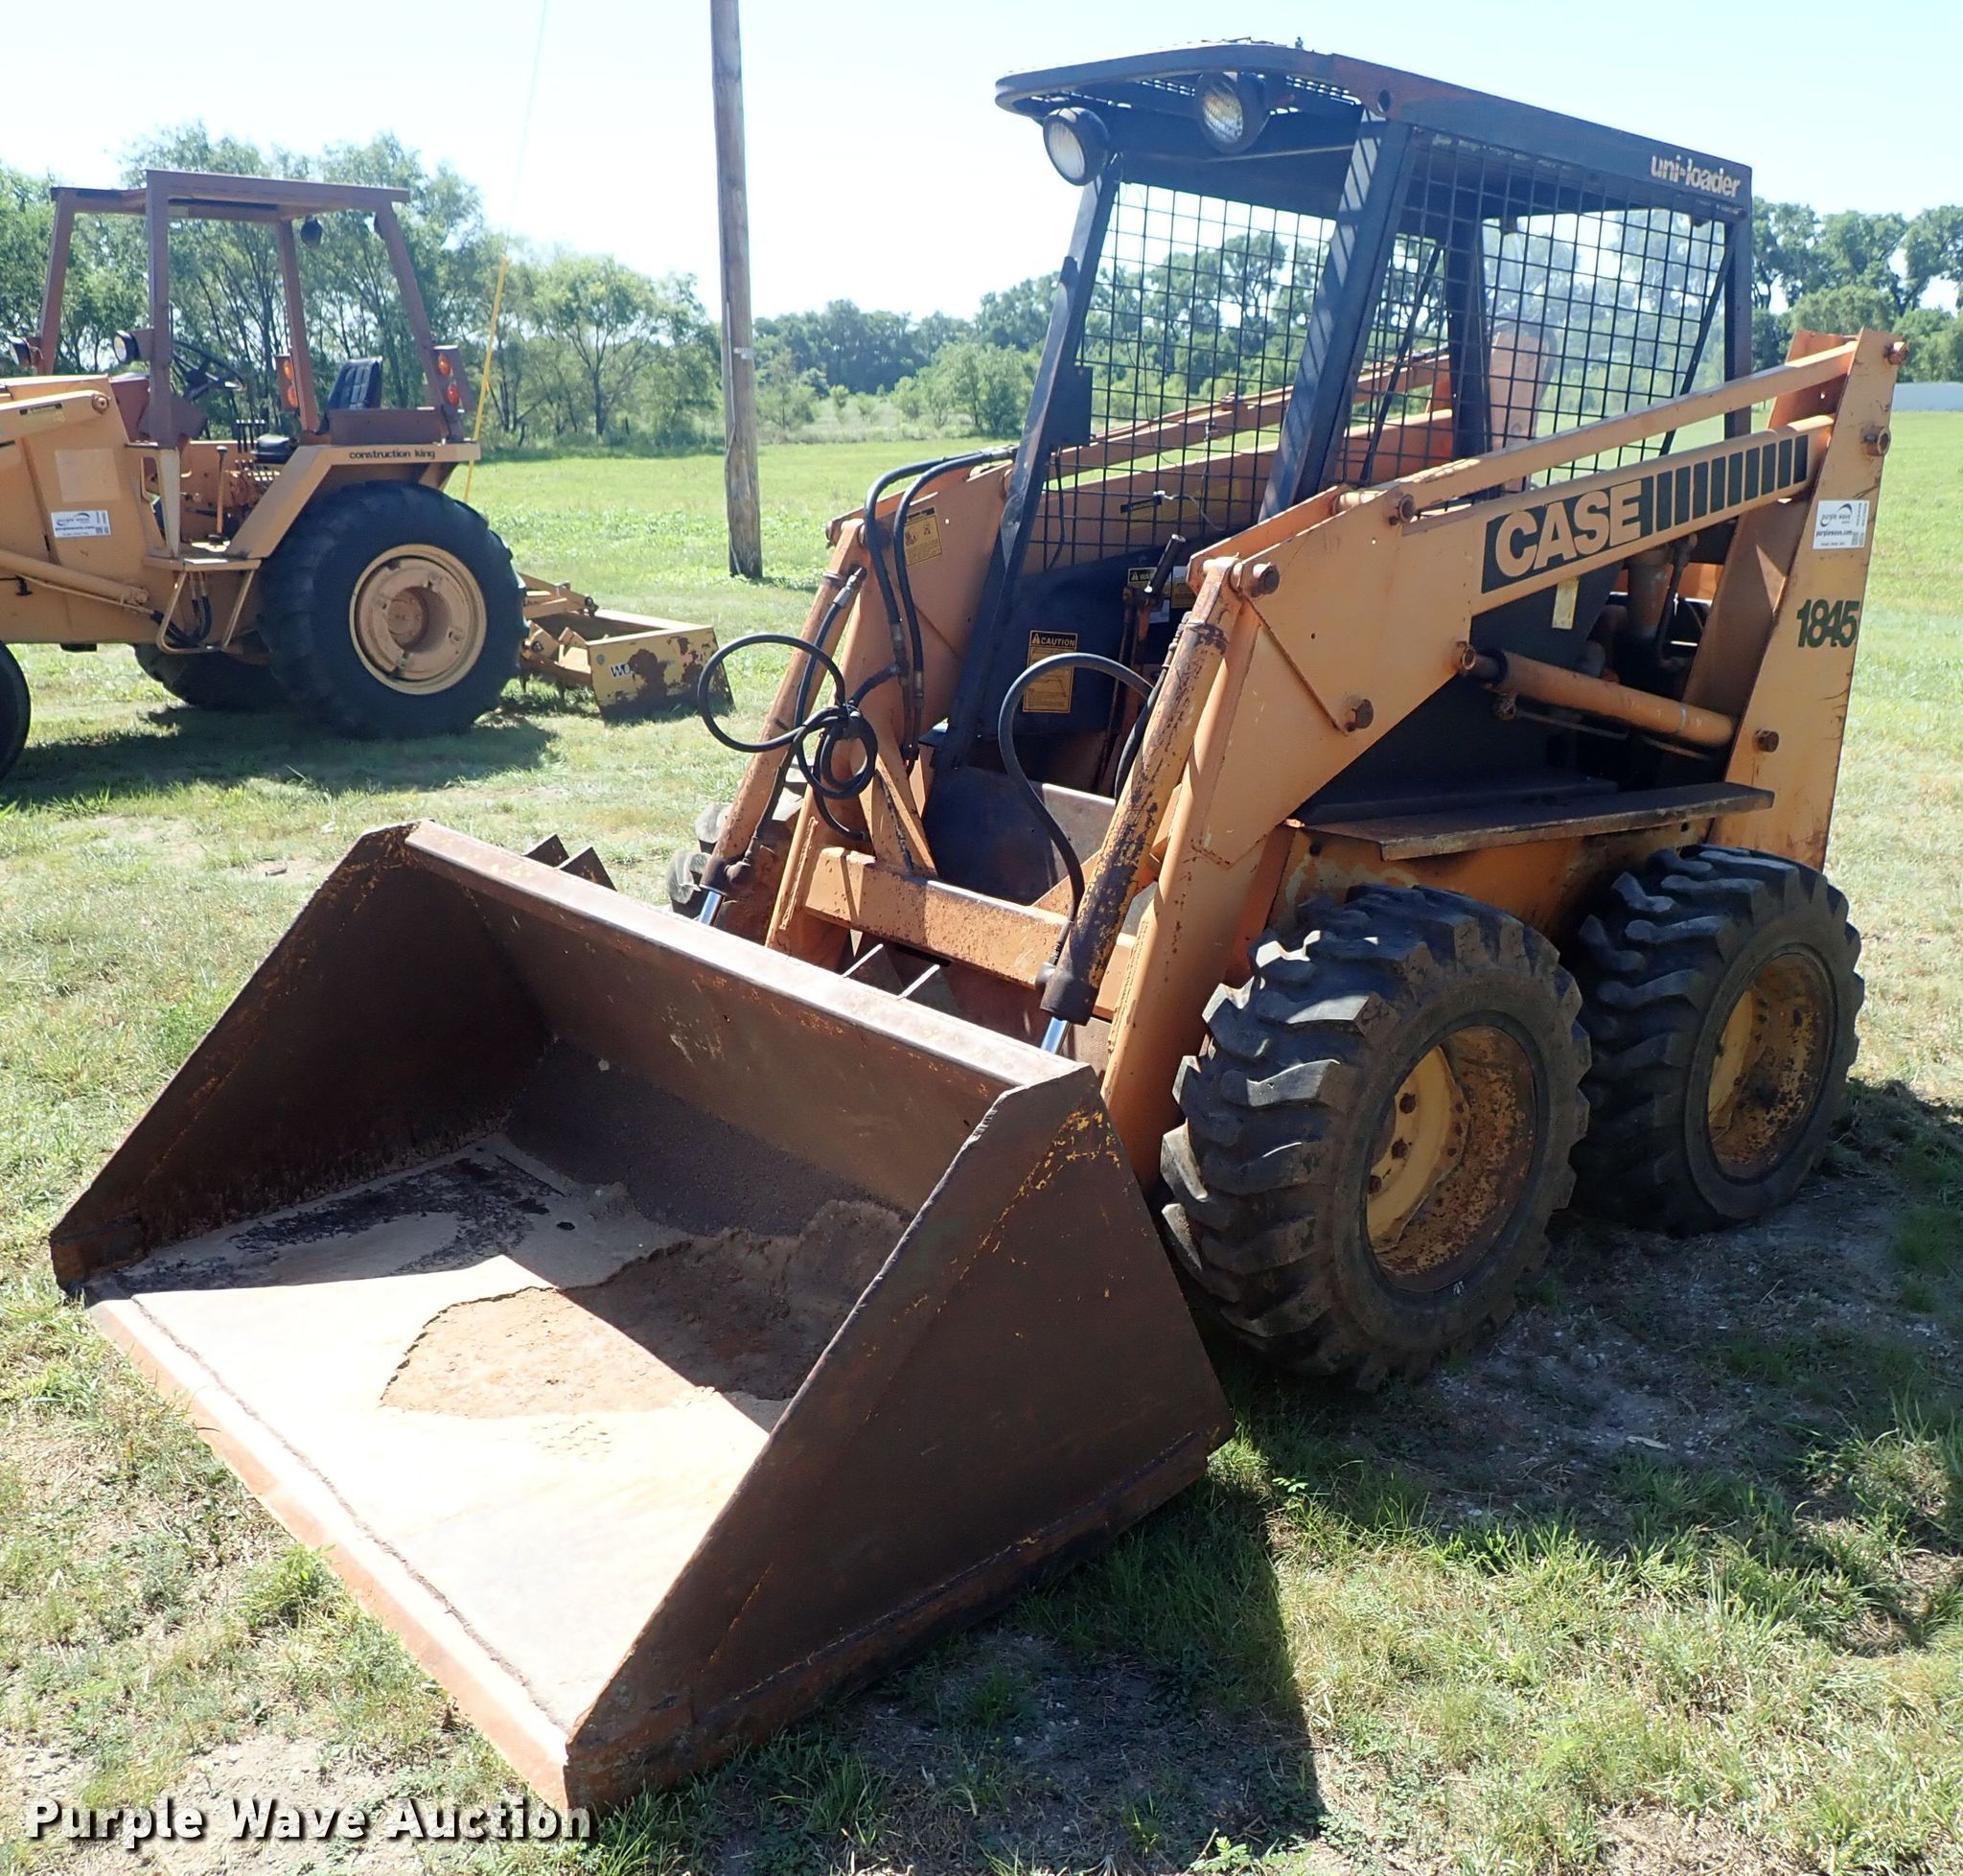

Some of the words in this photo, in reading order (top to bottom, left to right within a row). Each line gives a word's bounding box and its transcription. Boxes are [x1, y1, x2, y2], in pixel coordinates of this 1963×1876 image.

[1651, 154, 1741, 197] uni-loader
[349, 450, 410, 459] construction
[414, 449, 436, 459] king
[1495, 479, 1642, 577] CASE
[1041, 637, 1075, 646] CAUTION
[1796, 599, 1859, 649] 1845
